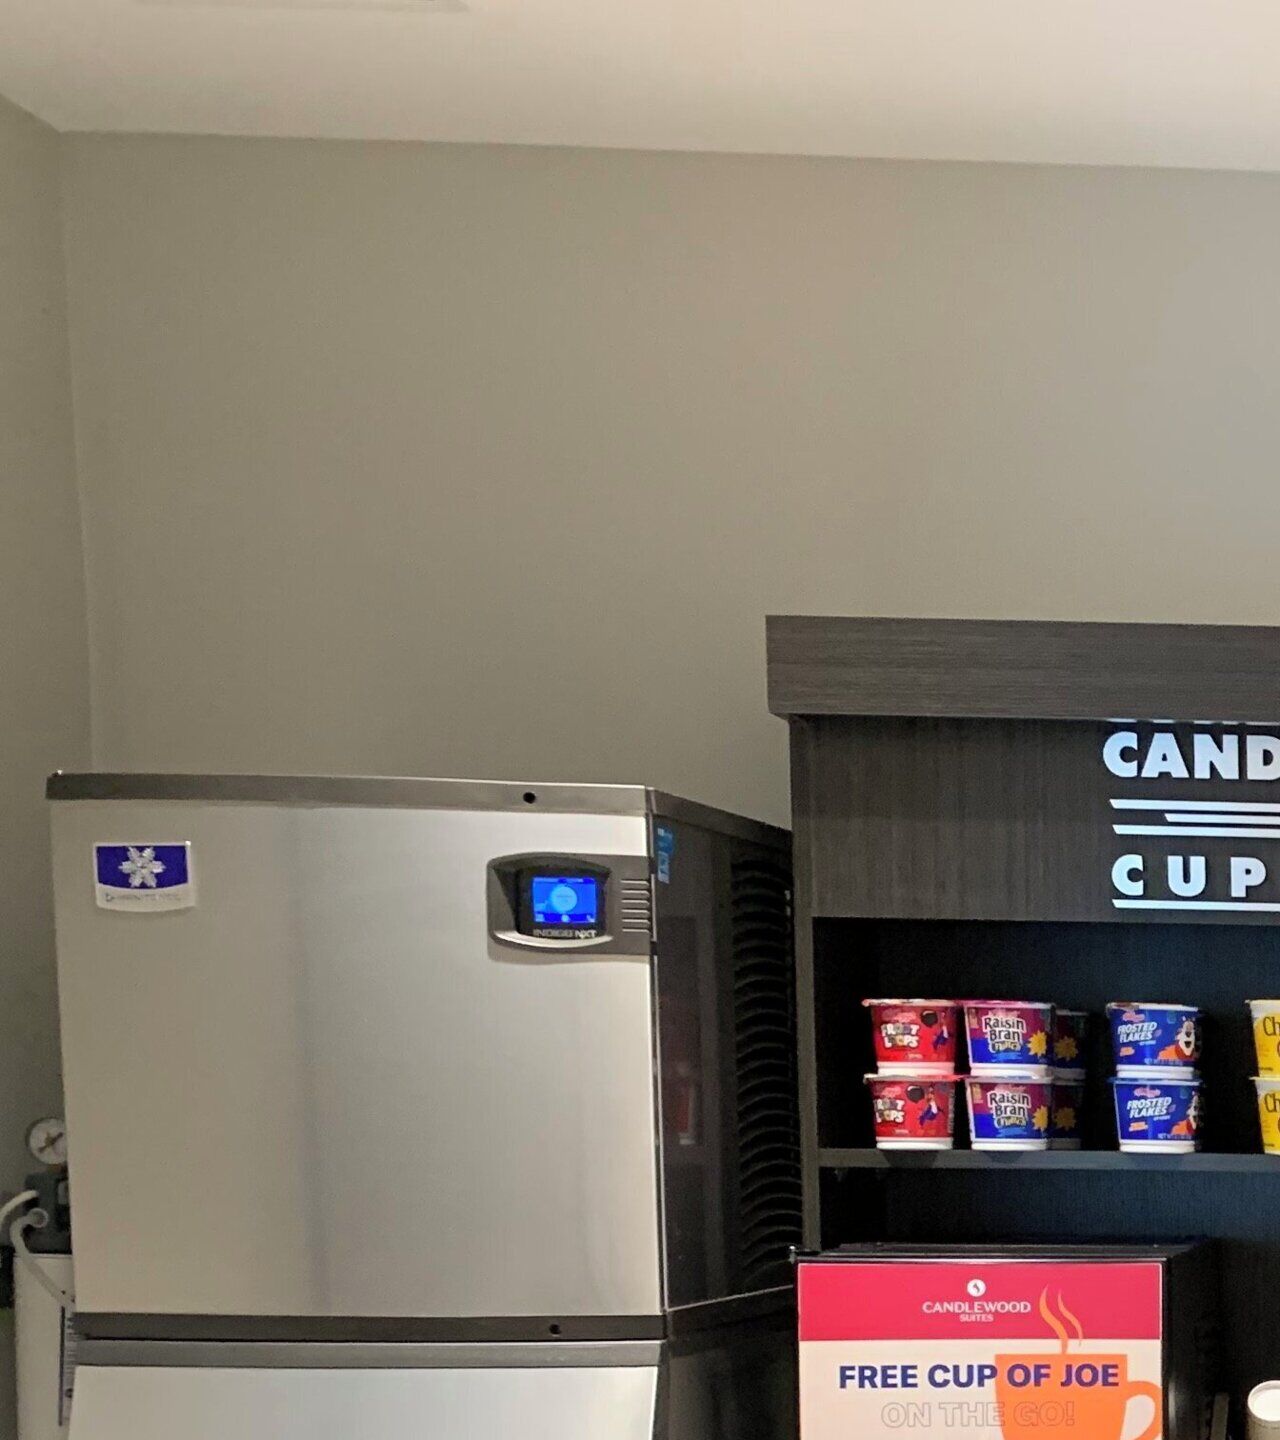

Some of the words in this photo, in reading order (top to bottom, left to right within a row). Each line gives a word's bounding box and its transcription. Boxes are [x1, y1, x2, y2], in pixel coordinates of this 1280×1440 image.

[983, 1016, 1027, 1032] Raisin
[1117, 1022, 1157, 1034] FROSTED
[990, 1029, 1021, 1042] Bran
[1119, 1033, 1153, 1043] FLAKES
[988, 1092, 1032, 1107] Raisin
[1127, 1096, 1172, 1110] FROSTED
[994, 1105, 1028, 1117] Bran
[1129, 1107, 1168, 1119] FLAKES
[922, 1300, 1031, 1314] CANDLEWOOD
[959, 1314, 994, 1322] SUITES
[839, 1365, 918, 1389] FREE
[927, 1364, 997, 1388] CUP
[1006, 1364, 1051, 1387] OF
[1060, 1364, 1119, 1388] JOE
[881, 1402, 931, 1428] ON
[939, 1402, 1005, 1428] THE
[1012, 1401, 1075, 1428] GO!
